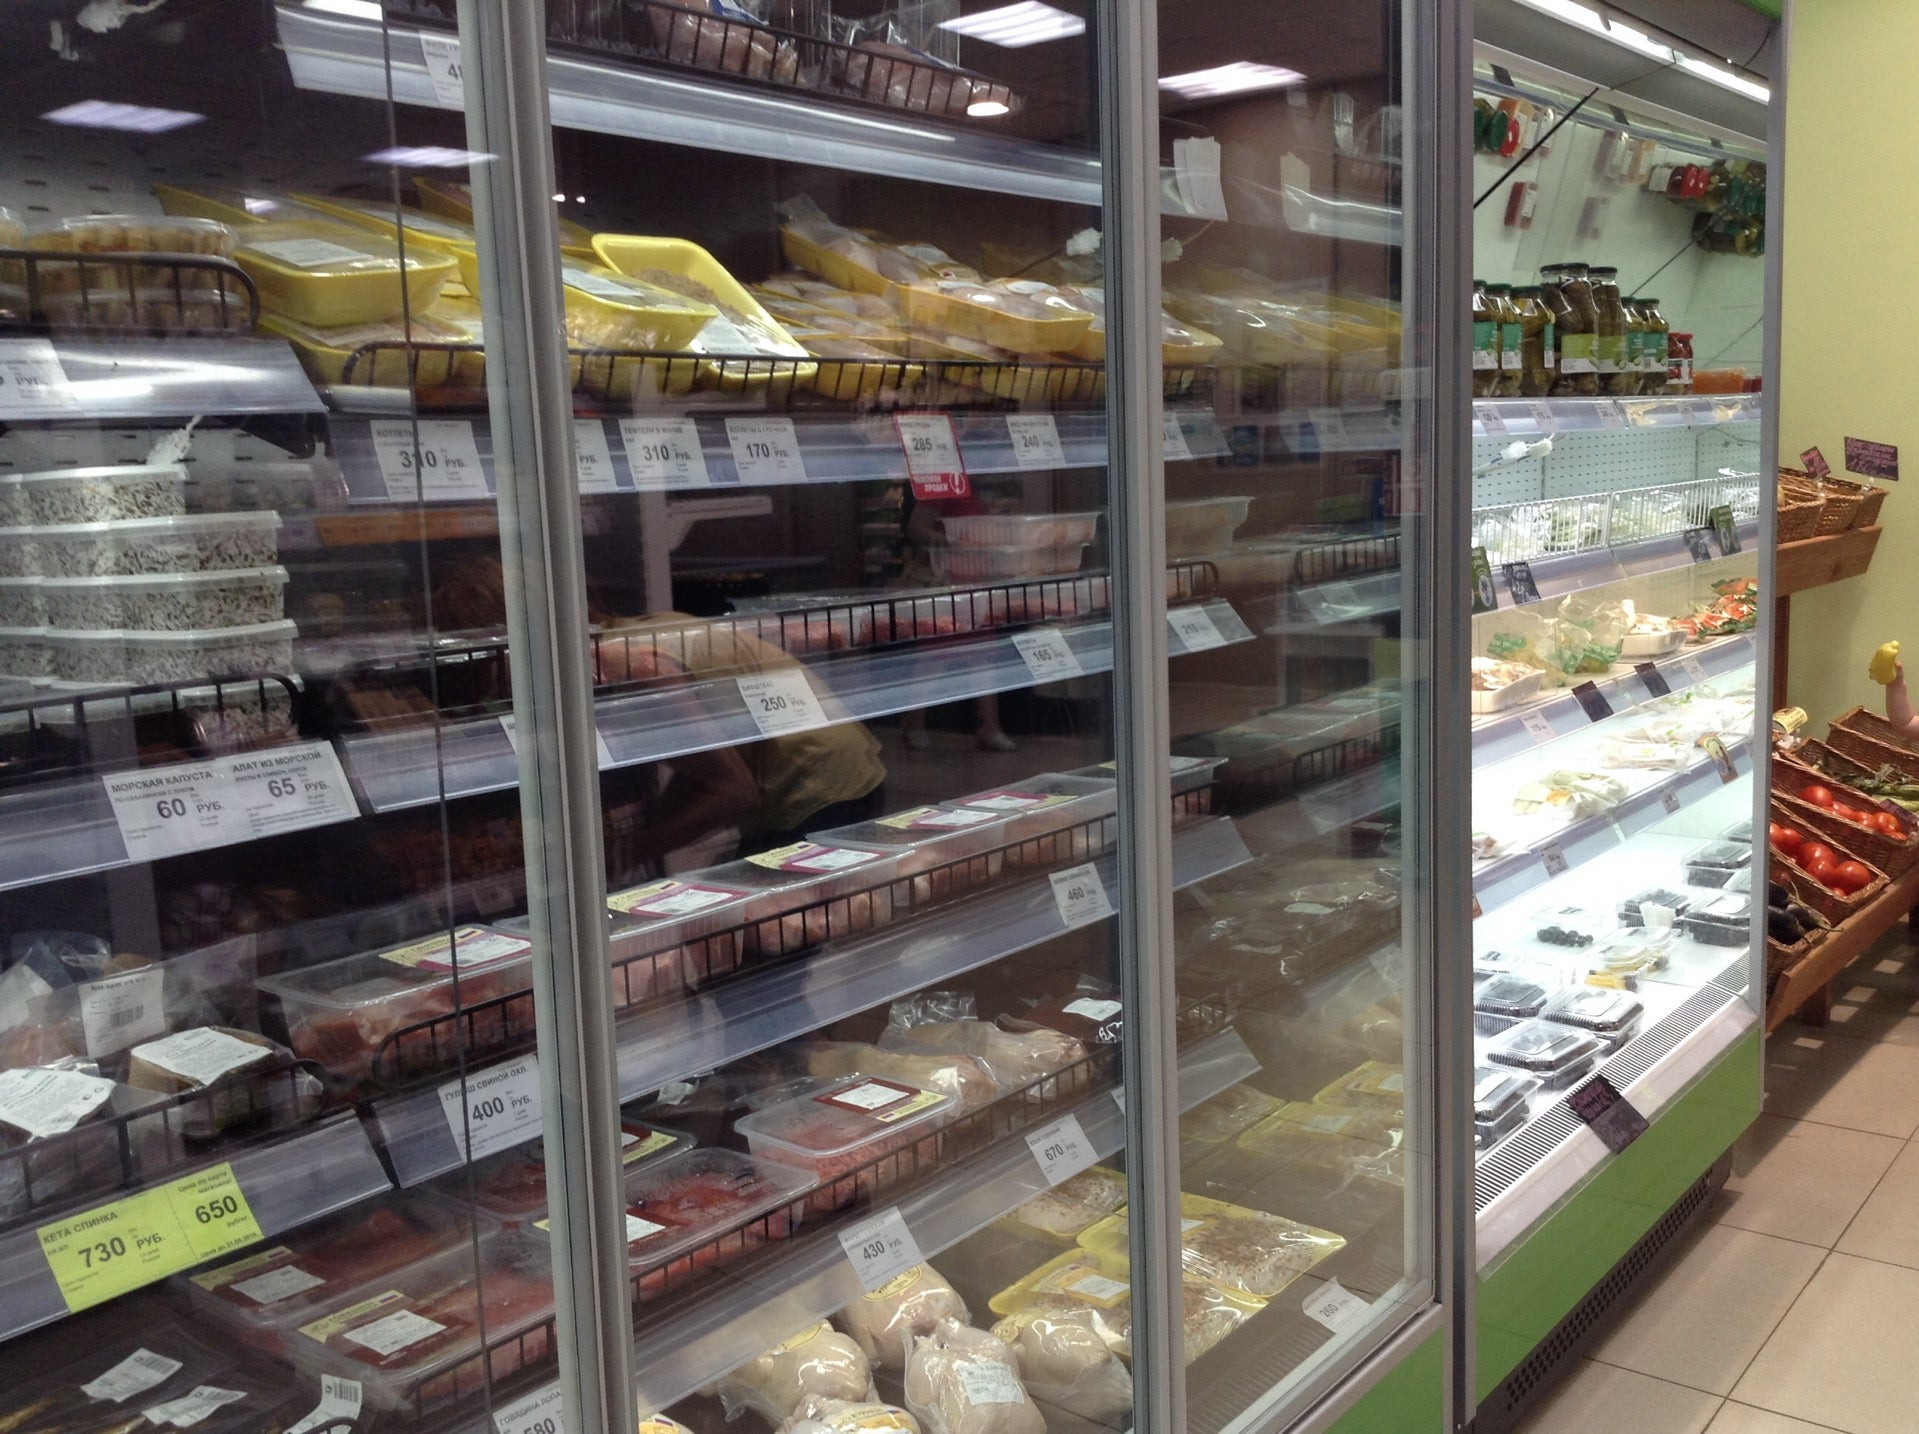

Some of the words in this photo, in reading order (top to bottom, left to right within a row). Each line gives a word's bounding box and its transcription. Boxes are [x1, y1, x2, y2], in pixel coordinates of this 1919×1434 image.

[746, 443, 770, 458] 170
[912, 438, 932, 451] 285
[1022, 435, 1039, 448] 240
[643, 444, 669, 461] 310
[761, 696, 787, 712] 250
[260, 760, 271, 768] ИЗ
[275, 751, 322, 765] МОРСКОЙ
[111, 778, 163, 793] МОРСКАЯ
[166, 771, 213, 784] КАПУСТА
[268, 777, 296, 797] 65
[304, 781, 330, 792] РУБ.
[157, 798, 186, 818] 60
[196, 801, 225, 813] РУБ.
[477, 1071, 509, 1090] СВИНОЙ
[472, 1097, 504, 1121] 400
[511, 1095, 533, 1109] РУБ.
[1044, 1144, 1064, 1161] 670
[195, 1195, 238, 1224] 650
[43, 1229, 72, 1244] КЕТА
[73, 1212, 118, 1233] СПИНКА
[78, 1237, 126, 1268] 730
[136, 1233, 166, 1249] РУБ.
[863, 1240, 885, 1260] 430
[500, 1402, 540, 1426] ГОВЯДИНА
